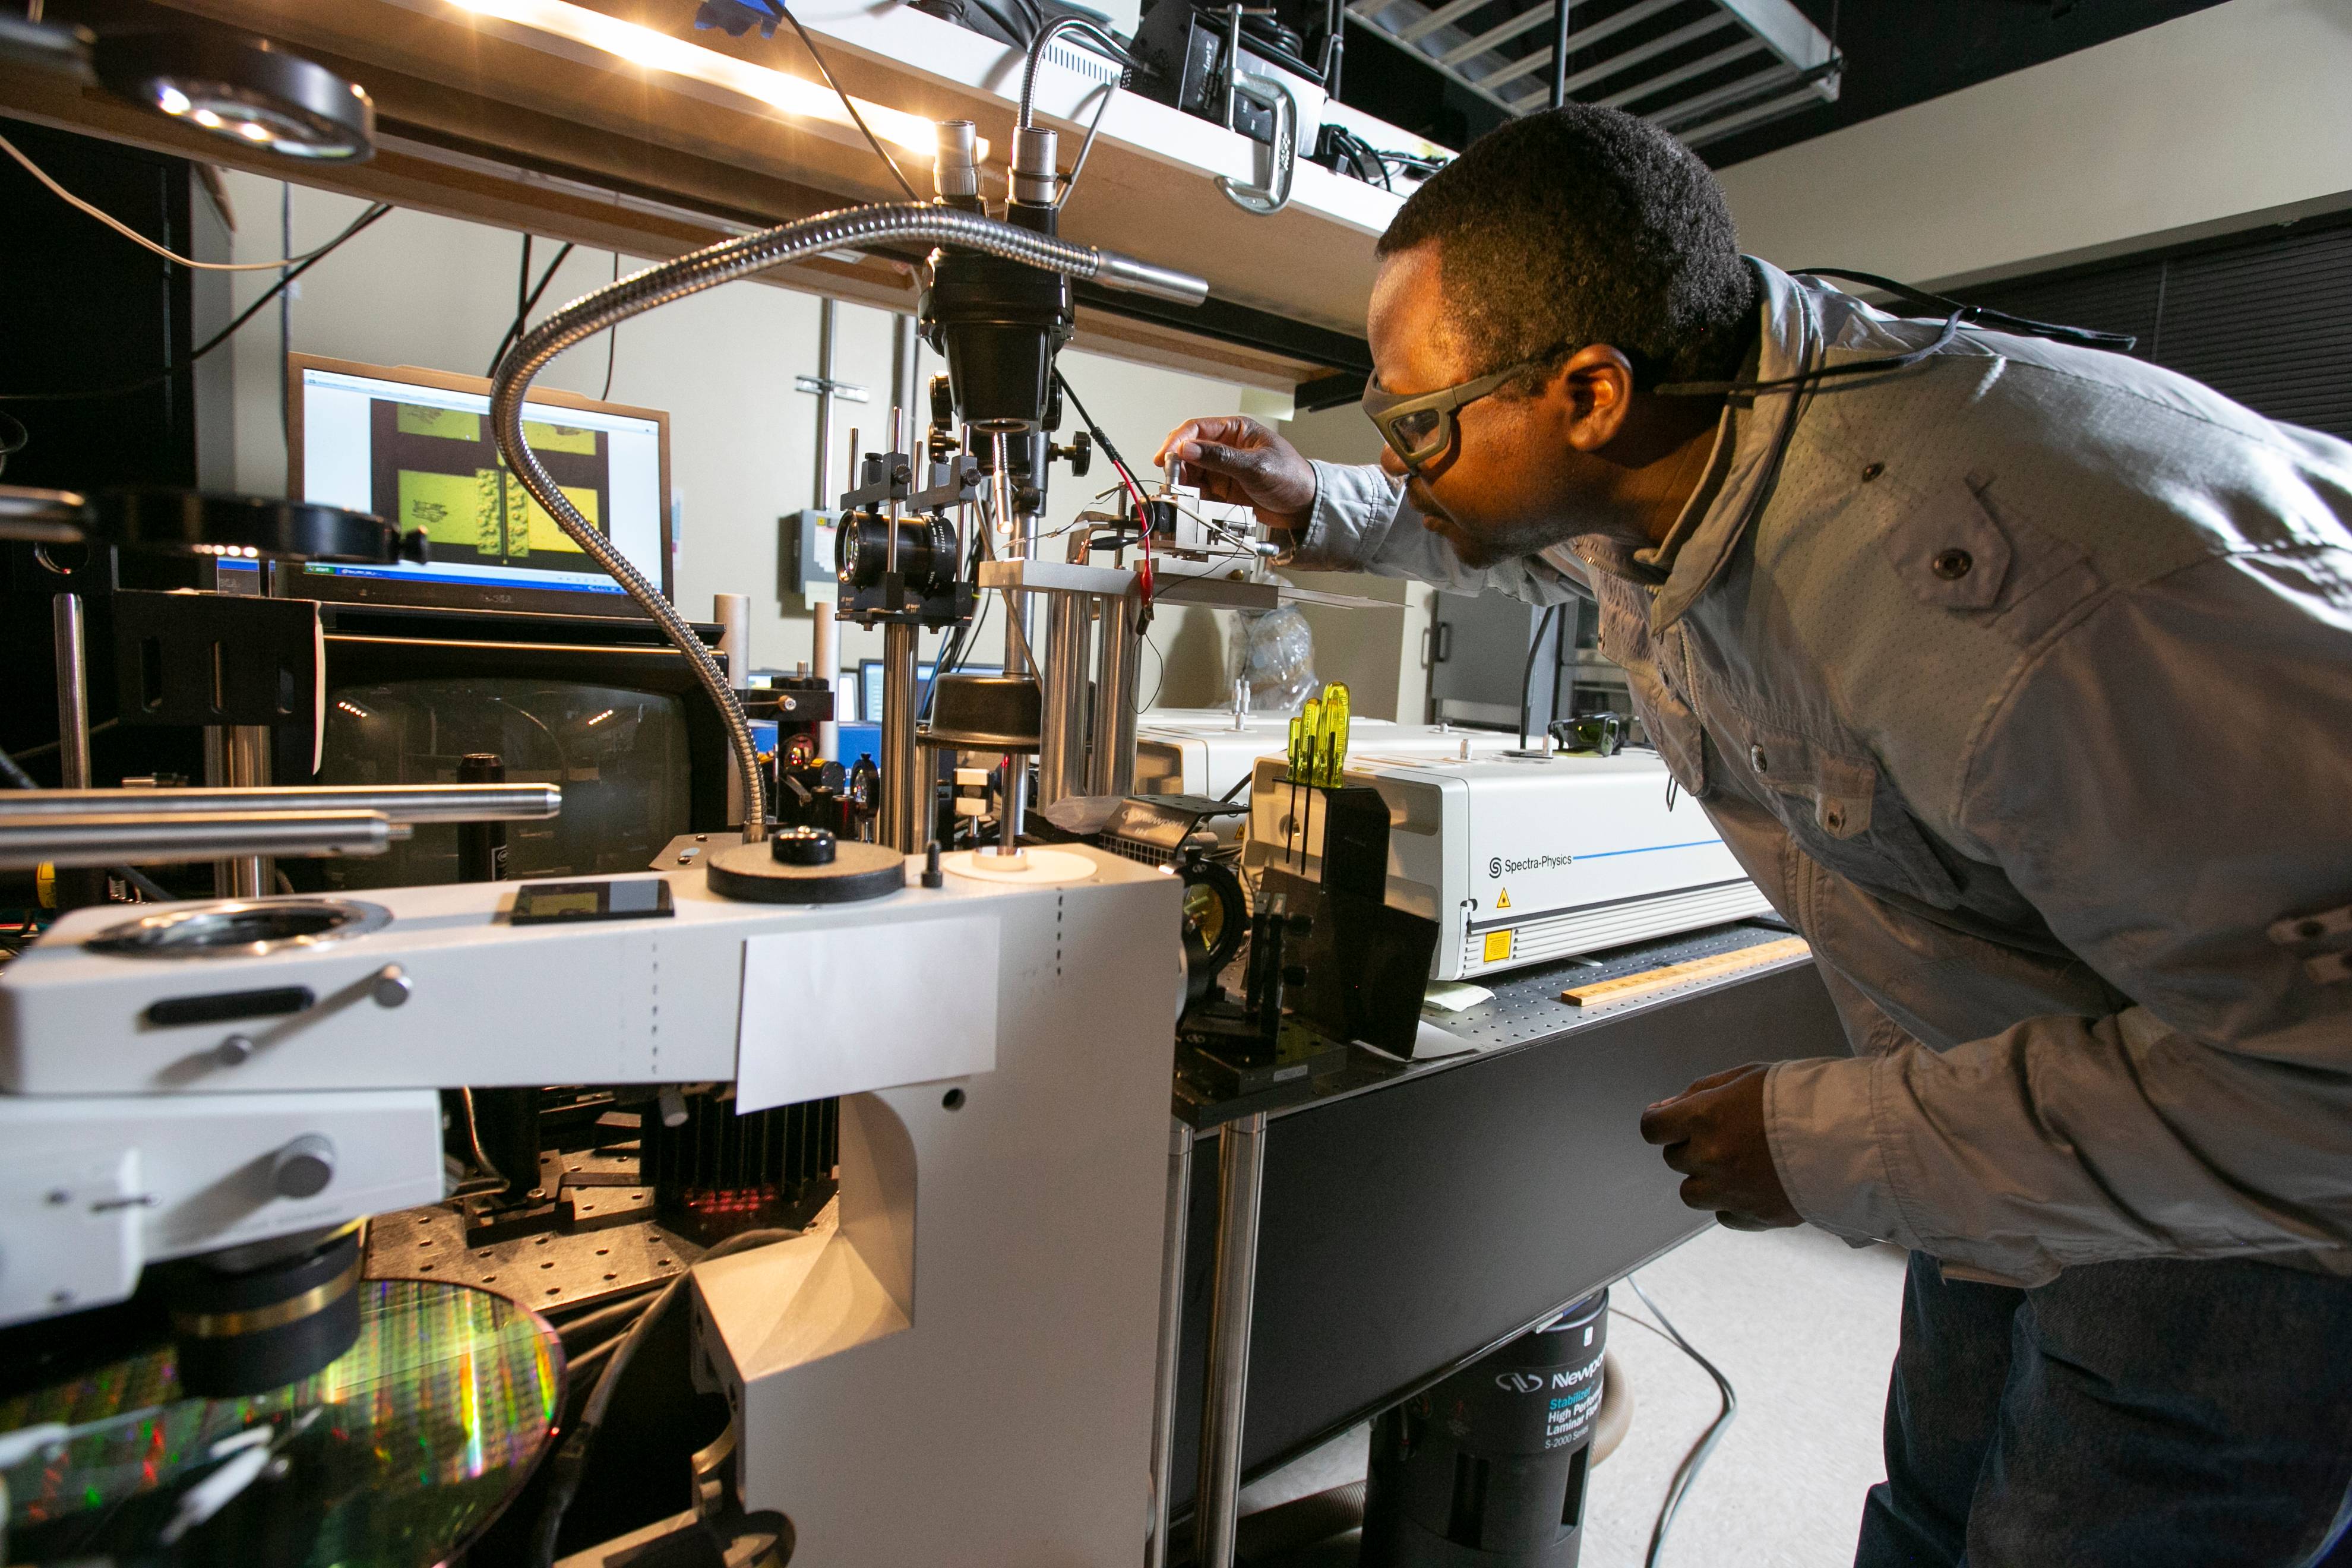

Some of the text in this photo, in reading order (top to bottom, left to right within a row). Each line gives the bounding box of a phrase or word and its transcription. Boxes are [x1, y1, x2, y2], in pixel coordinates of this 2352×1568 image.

[1140, 812, 1185, 827] Newport
[1505, 853, 1572, 874] Spectra-Physics
[1549, 1386, 1591, 1410] Stabilizer
[1548, 1408, 1572, 1424] High
[1546, 1414, 1585, 1437] Laminar
[1544, 1433, 1573, 1449] S-2000
